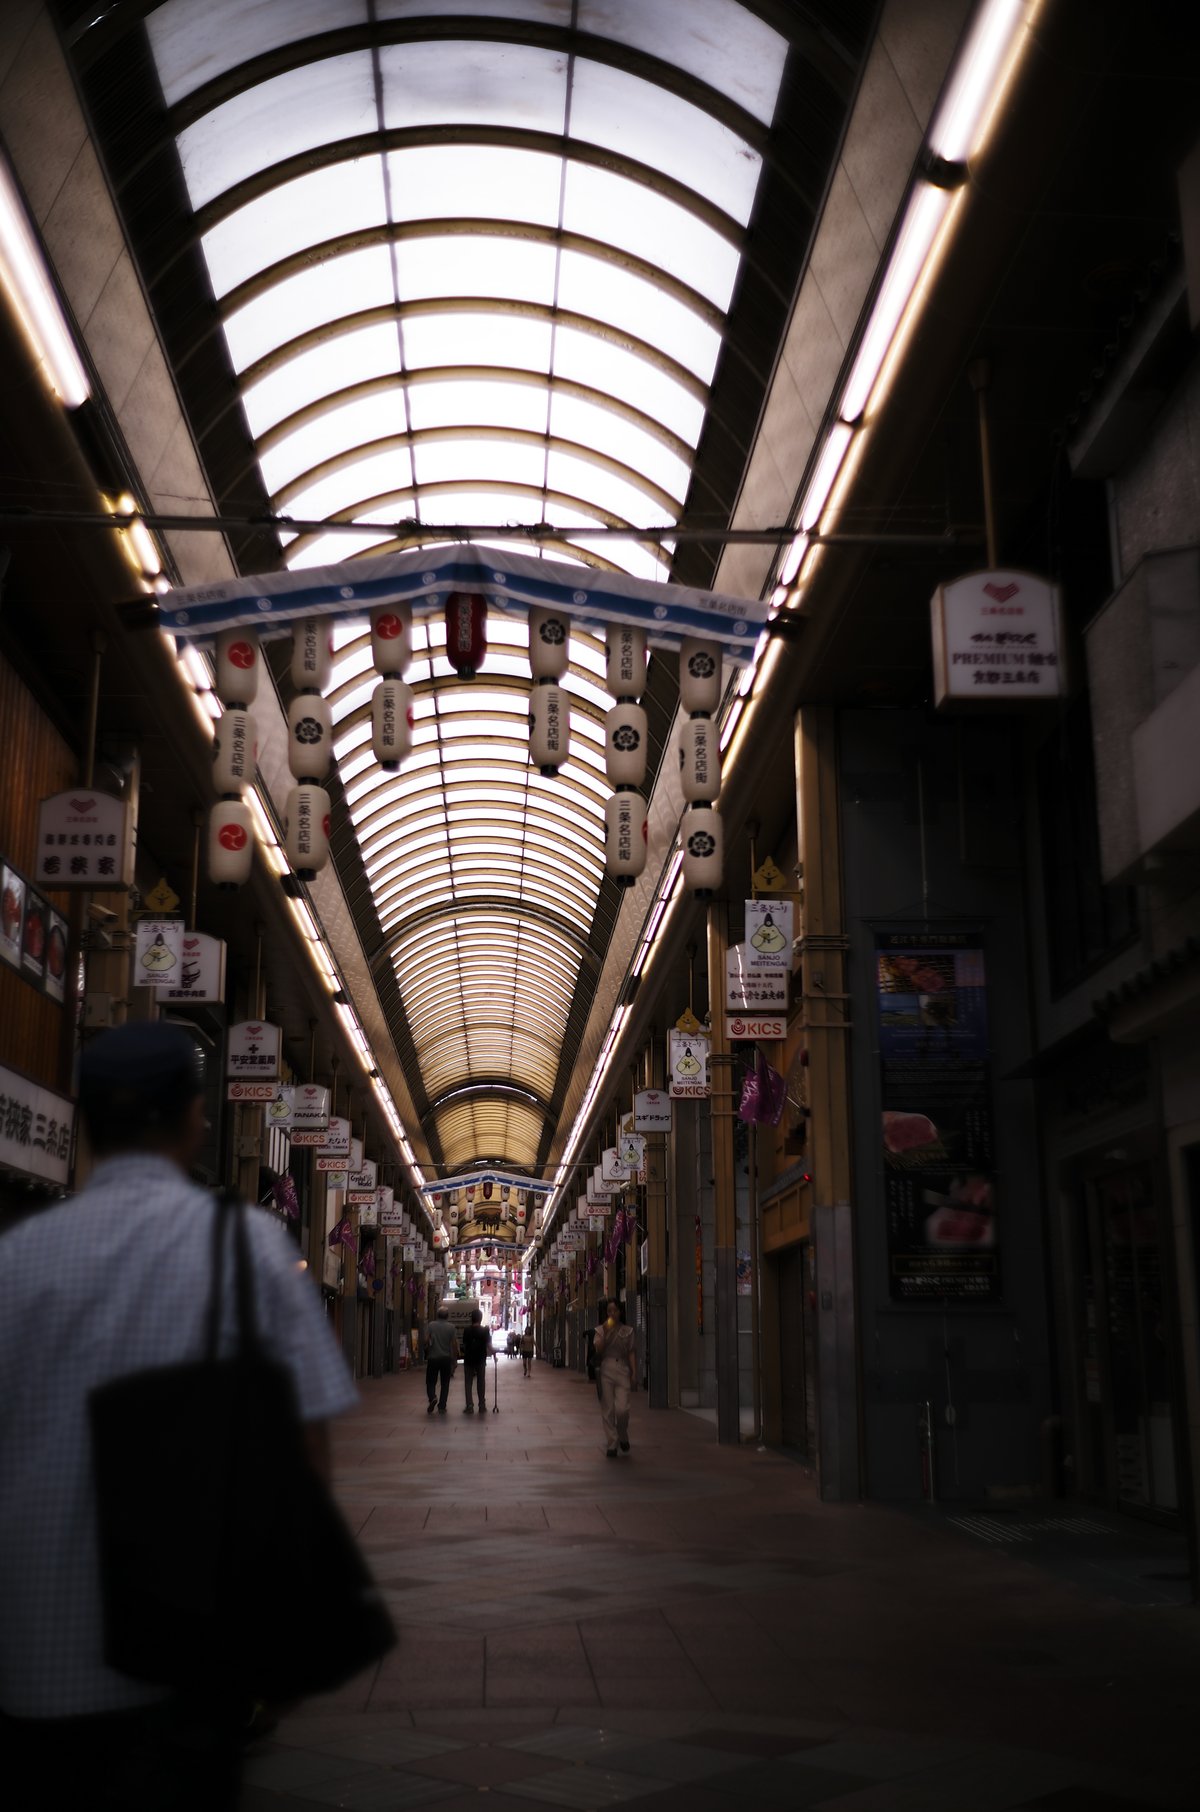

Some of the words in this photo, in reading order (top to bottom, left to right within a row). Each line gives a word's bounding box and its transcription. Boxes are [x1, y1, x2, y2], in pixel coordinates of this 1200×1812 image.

[952, 653, 1026, 664] PREMIUM
[383, 687, 395, 746] 三条名店街
[547, 692, 560, 751] 三条名店街
[231, 716, 246, 777] 三条名店街
[694, 725, 708, 783] 三条名店街
[298, 793, 312, 854] 三条名店街
[618, 800, 632, 861] 三条名店街
[747, 1022, 782, 1035] KICS
[231, 1054, 276, 1065] 平安堂薬局
[244, 1087, 273, 1097] KICS
[685, 1086, 711, 1096] KICS
[303, 1134, 325, 1143] KICS
[327, 1160, 347, 1169] KICS
[358, 1194, 374, 1202] KICS
